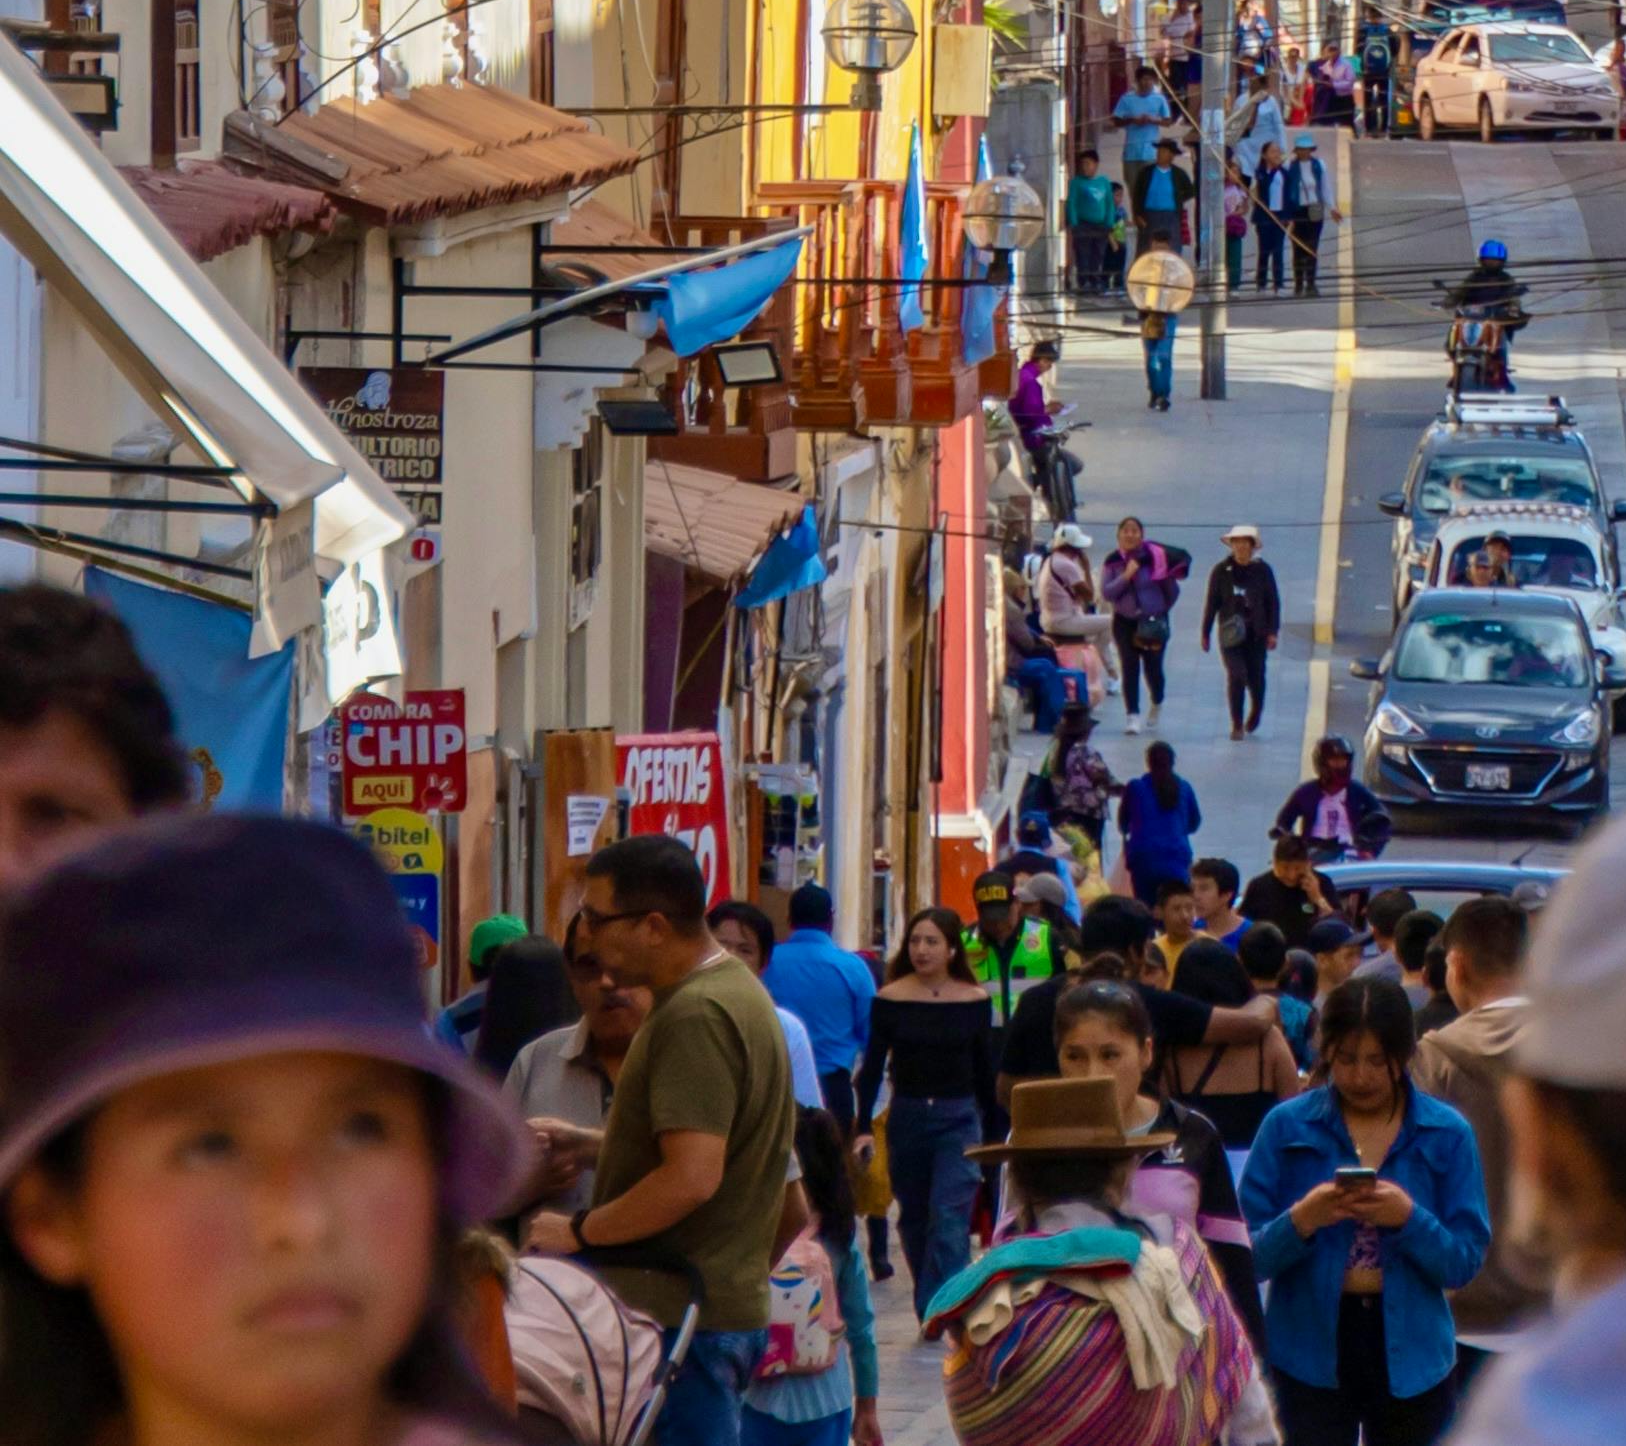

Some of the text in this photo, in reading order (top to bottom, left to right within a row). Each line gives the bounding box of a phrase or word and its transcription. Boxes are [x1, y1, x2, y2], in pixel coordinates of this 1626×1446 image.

[351, 436, 441, 457] ULTORIO
[347, 724, 464, 767] CHIP
[624, 747, 711, 806] OFERTAS
[361, 779, 405, 801] AQUÍ
[377, 827, 430, 845] bitel
